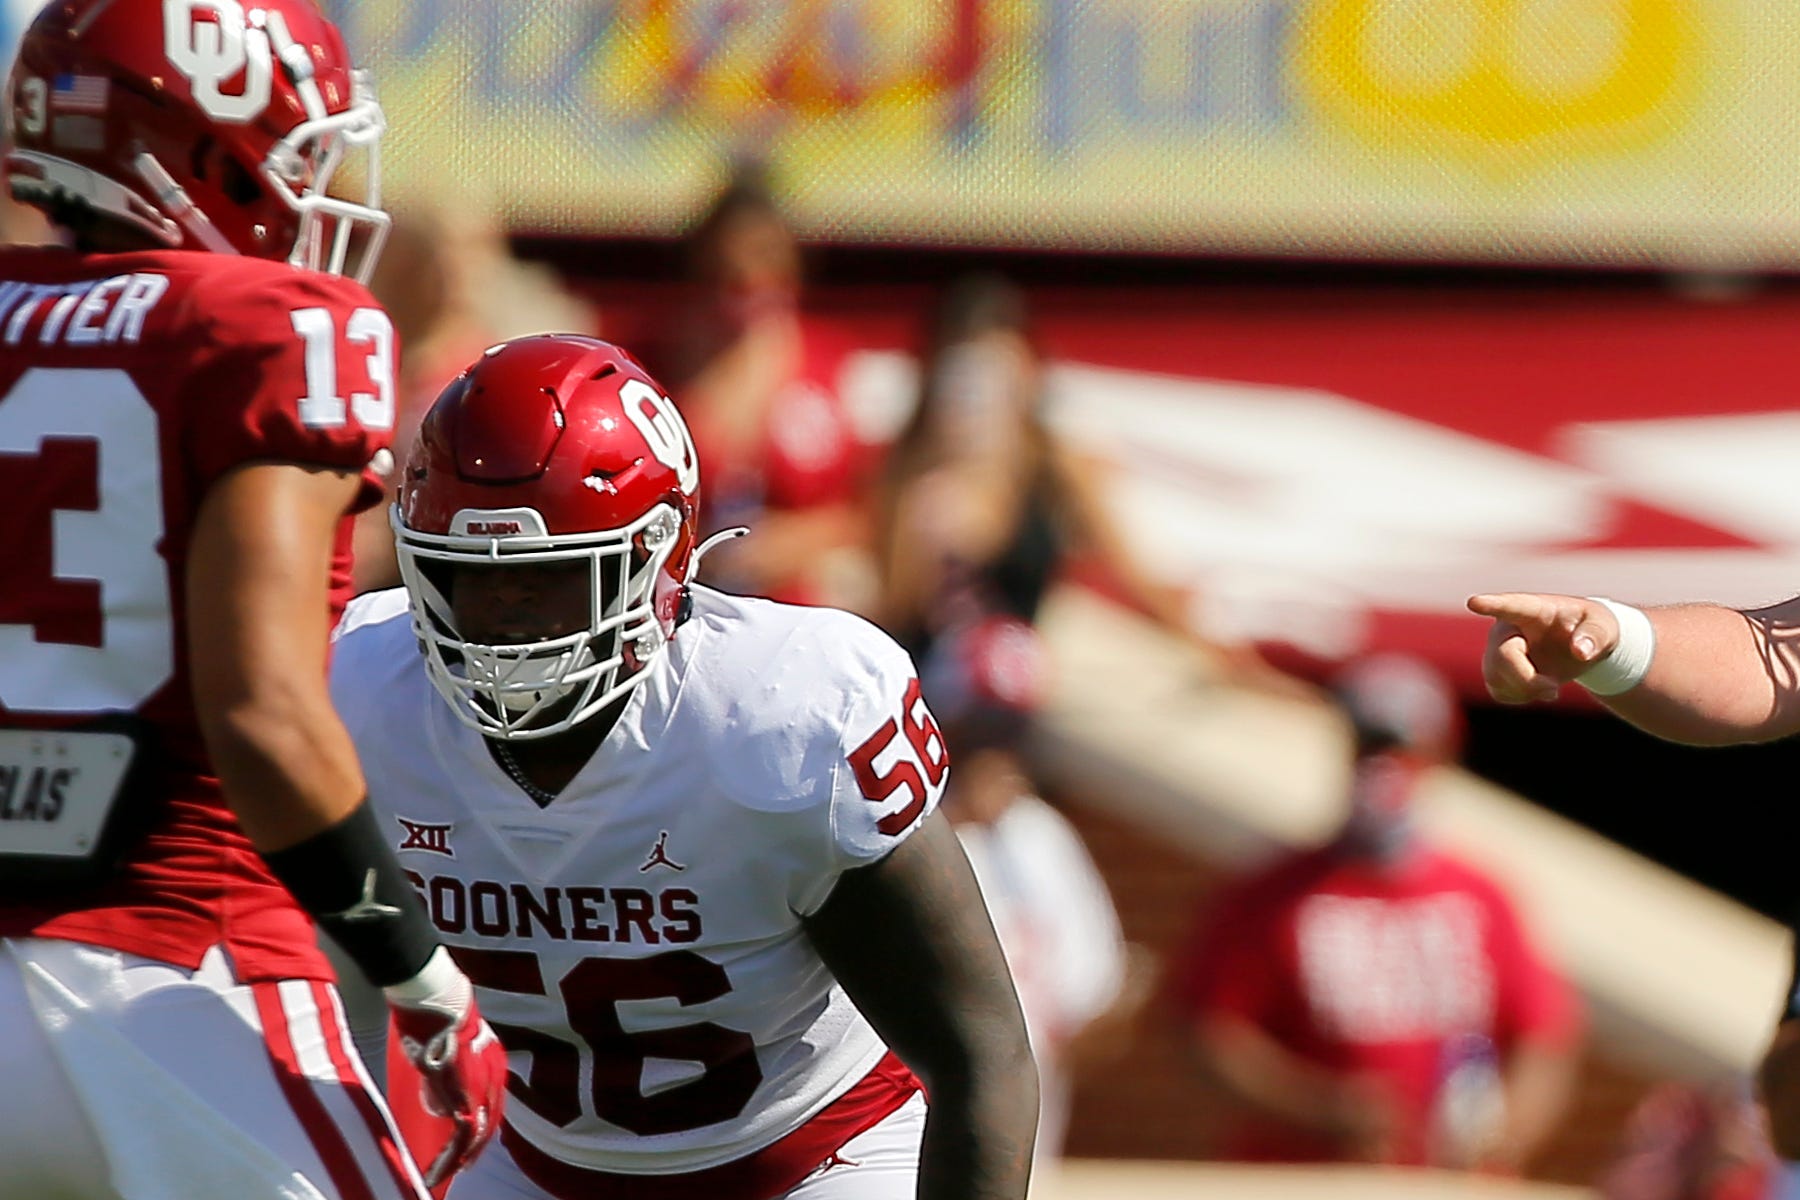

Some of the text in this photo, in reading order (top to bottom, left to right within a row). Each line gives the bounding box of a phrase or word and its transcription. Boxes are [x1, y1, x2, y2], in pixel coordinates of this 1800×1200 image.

[290, 306, 397, 429] 13
[618, 378, 699, 497] OU
[0, 764, 74, 823] LAS
[844, 676, 950, 838] 56
[398, 816, 454, 858] XII
[442, 944, 764, 1138] 56
